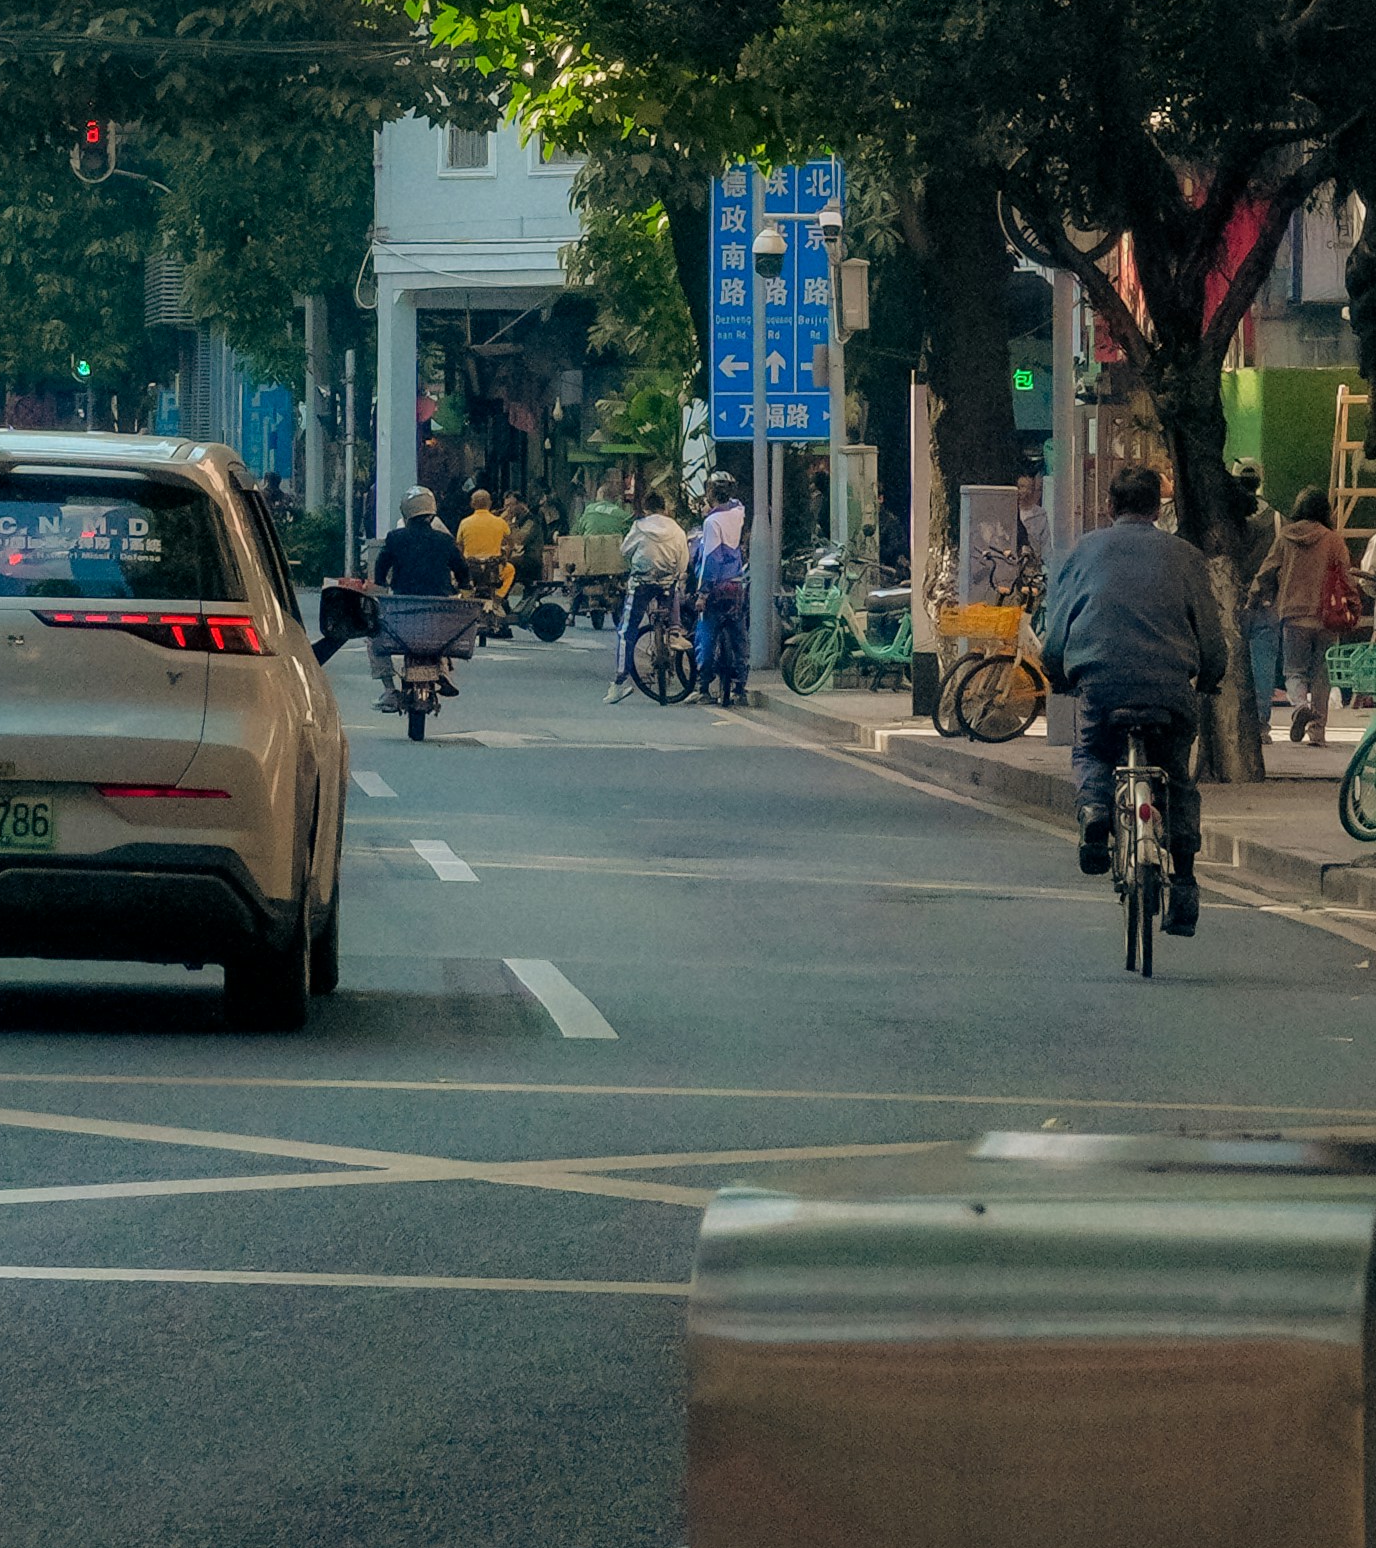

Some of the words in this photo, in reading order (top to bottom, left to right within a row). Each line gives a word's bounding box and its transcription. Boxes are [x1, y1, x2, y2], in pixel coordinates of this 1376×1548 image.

[719, 168, 748, 307] 德政南路
[765, 166, 789, 306] 珠路
[803, 168, 832, 307] 北京路
[797, 314, 829, 327] Beijin
[738, 403, 810, 429] 万福路
